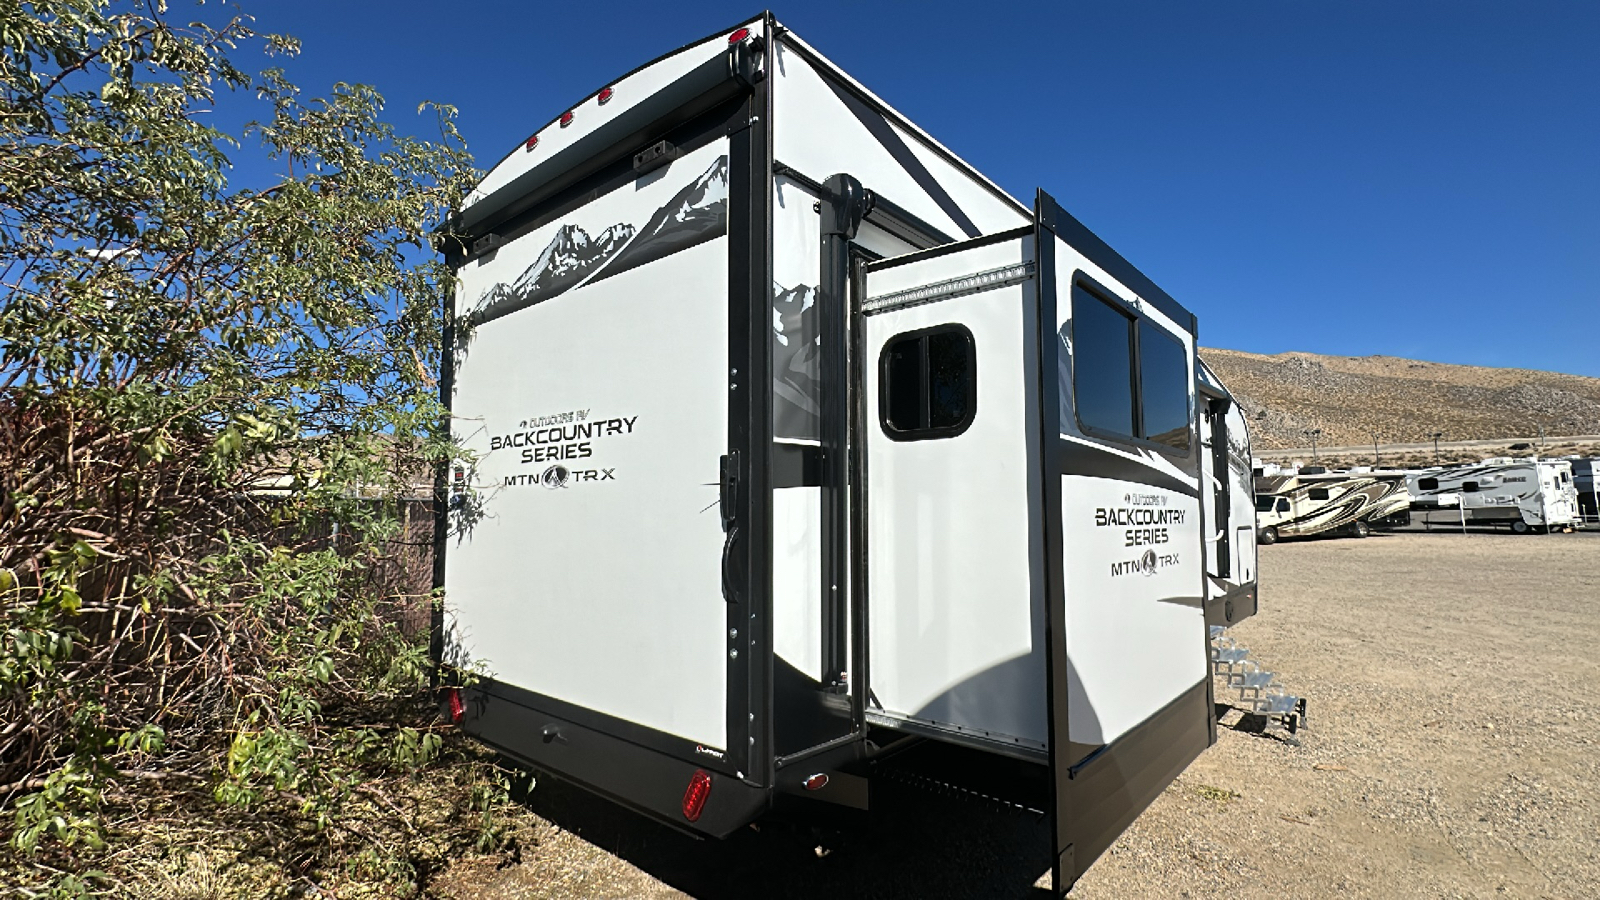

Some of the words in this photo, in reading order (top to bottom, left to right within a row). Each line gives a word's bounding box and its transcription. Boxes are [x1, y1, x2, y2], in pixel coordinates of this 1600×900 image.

[490, 415, 638, 450] BACKCOUNTRY
[521, 442, 592, 463] SERIES
[504, 473, 539, 486] MTN
[572, 467, 616, 482] TRX
[1095, 507, 1185, 526] BACKCOUNTRY
[1125, 528, 1169, 547] SERIES
[1111, 559, 1140, 577] MTN
[1158, 553, 1180, 568] TRX
